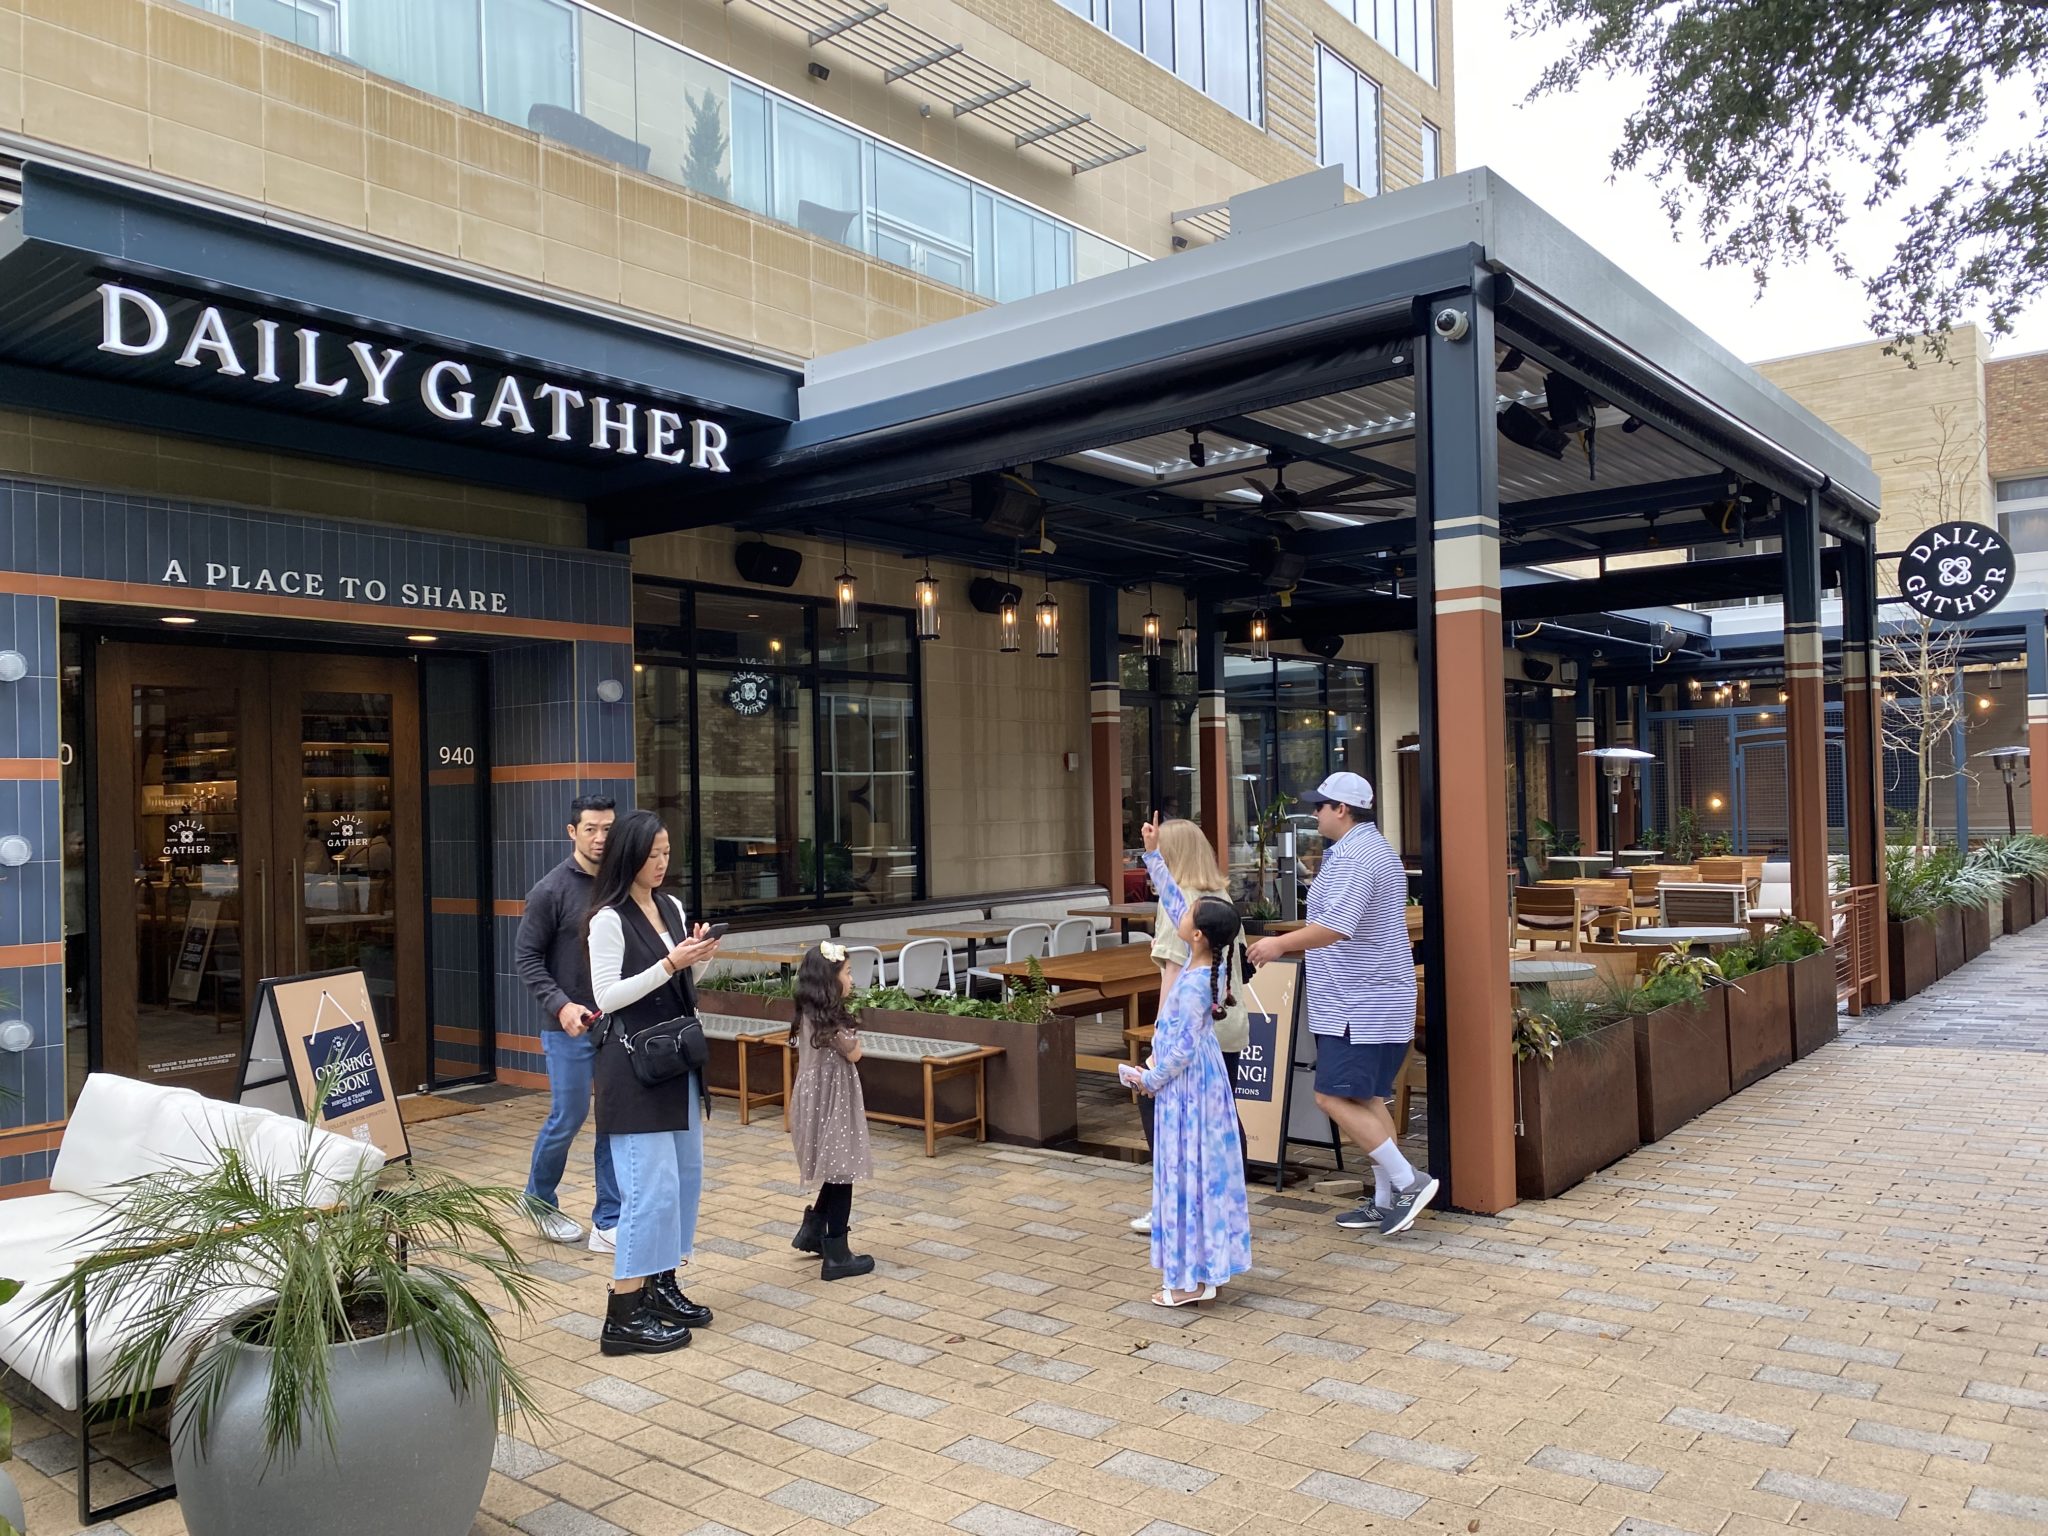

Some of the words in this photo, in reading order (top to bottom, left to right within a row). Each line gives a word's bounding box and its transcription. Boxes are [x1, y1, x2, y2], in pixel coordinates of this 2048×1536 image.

[96, 283, 403, 405] DAILY
[420, 360, 730, 473] GATHER
[1910, 527, 2001, 564] DAILY
[162, 559, 187, 583] A
[206, 563, 325, 596] PLACE
[339, 576, 386, 601] TO
[401, 583, 508, 613] SHARE
[1906, 567, 2007, 615] GATHER
[439, 746, 475, 765] 940
[169, 819, 206, 833] DAILY
[332, 814, 364, 827] DAILY
[162, 845, 211, 855] GATHER
[327, 838, 369, 847] GATHER
[315, 1052, 373, 1081] OPENING
[328, 1072, 370, 1097] SOON!
